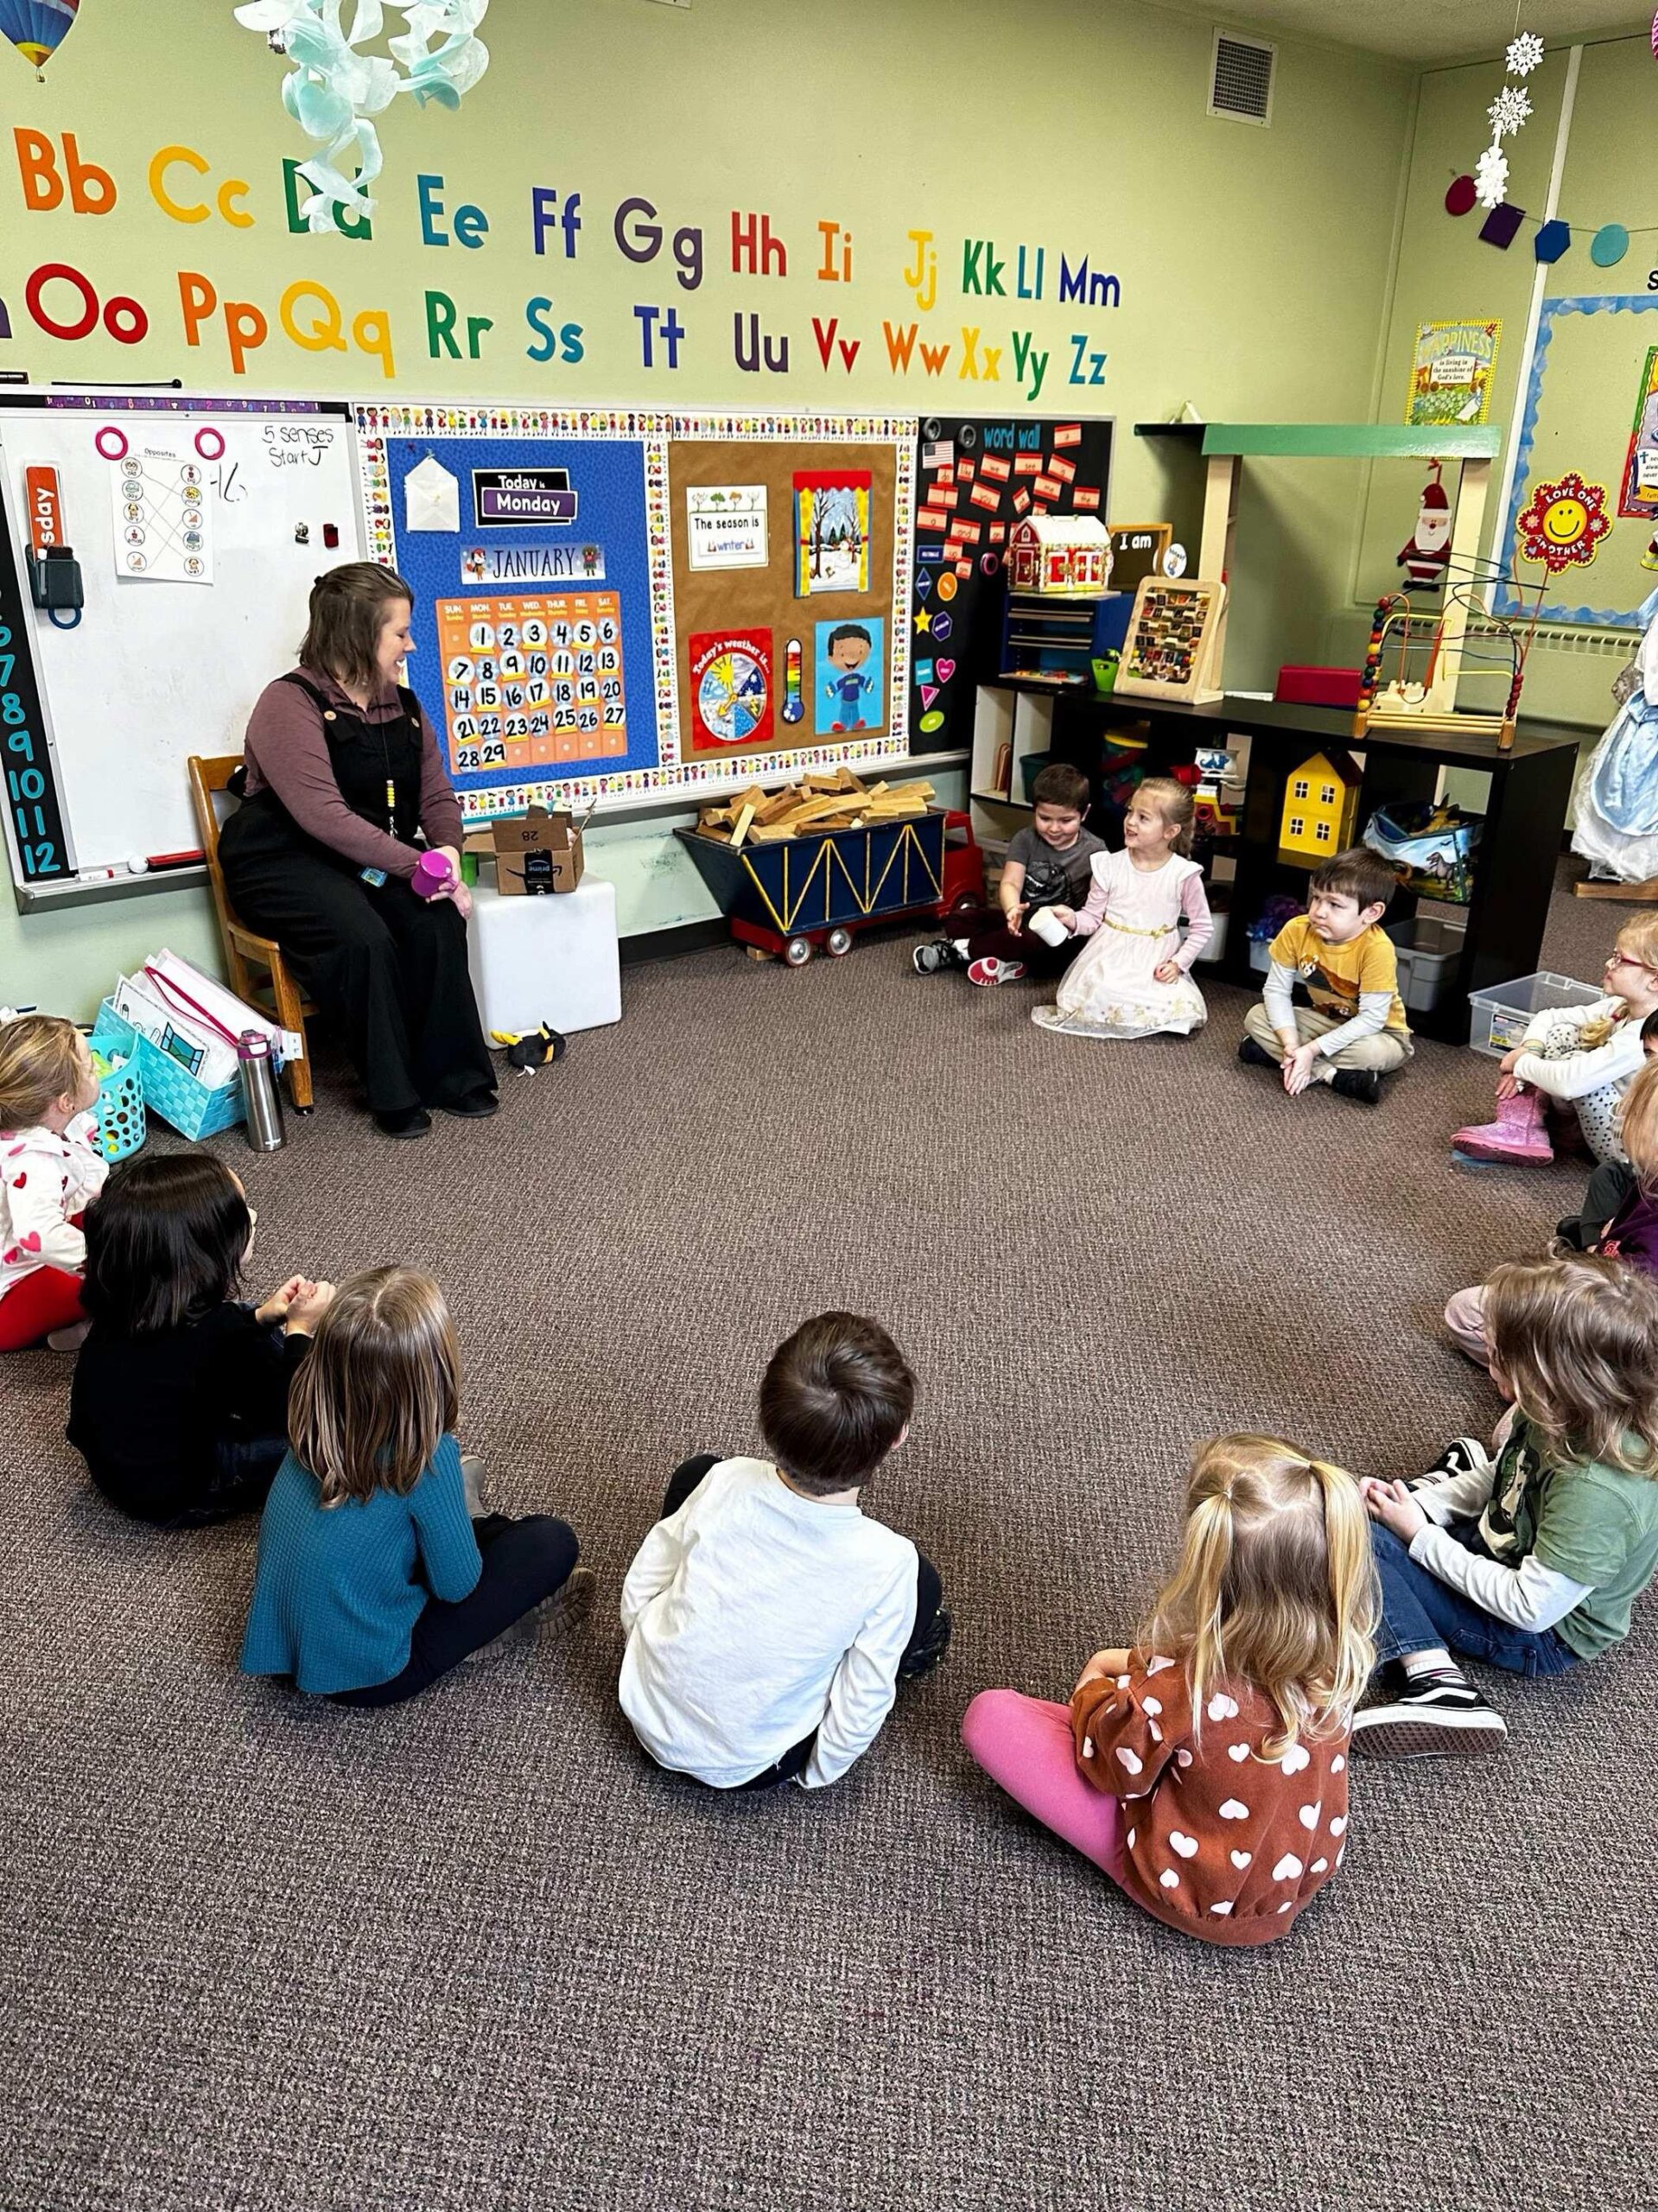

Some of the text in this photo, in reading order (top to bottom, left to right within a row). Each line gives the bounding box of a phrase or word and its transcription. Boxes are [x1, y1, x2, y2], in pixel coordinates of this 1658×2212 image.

[13, 127, 118, 215] Bb
[149, 146, 256, 229] Cc
[416, 174, 489, 249] Ee
[532, 187, 581, 258] Ff
[614, 197, 703, 290] Gg
[731, 211, 787, 277] Hh
[817, 220, 852, 283] Ii
[905, 230, 937, 311] Jj
[962, 238, 1007, 296] Kk
[1017, 245, 1044, 301] Ll
[1059, 251, 1121, 308] Mm
[25, 263, 149, 345] Oo
[177, 271, 269, 374] Pp
[279, 279, 396, 378] Qq
[424, 290, 495, 360] Rr
[525, 296, 585, 364] Ss
[633, 305, 685, 370] Tt
[734, 312, 789, 373] Uu
[811, 317, 861, 375] Vv
[882, 321, 950, 377] Ww
[959, 327, 1003, 381] Xx
[1012, 330, 1049, 402] Yy
[1068, 334, 1108, 385] Zz
[263, 425, 334, 444] 5 senses
[983, 423, 1041, 449] word wall
[144, 448, 176, 458] Opposites
[498, 474, 537, 490] Today
[496, 493, 561, 516] Monday
[1545, 487, 1597, 512] LOVE ONE
[35, 487, 55, 545] sday
[695, 518, 759, 531] The season is
[716, 539, 745, 552] winter
[1120, 534, 1152, 550] I am
[1534, 536, 1586, 556] ANOTHER
[492, 547, 575, 579] JANUARY
[598, 597, 612, 607] SAT.
[480, 622, 613, 645] 1 2 3 4 5 6
[456, 652, 614, 680] 7 8 9 10 11 12 13
[692, 642, 723, 674] Today's
[724, 639, 760, 657] weather
[454, 681, 620, 709] 14 15 16 17 18 19 20
[2, 694, 25, 725] 8
[458, 708, 624, 739] 21 22 23 24 25 26 27
[8, 730, 34, 761] 9
[458, 744, 505, 767] 28 29
[9, 769, 45, 801] 10
[16, 806, 46, 838] 11
[522, 830, 539, 842] 28
[24, 842, 60, 874] 12
[529, 865, 550, 874] prime
